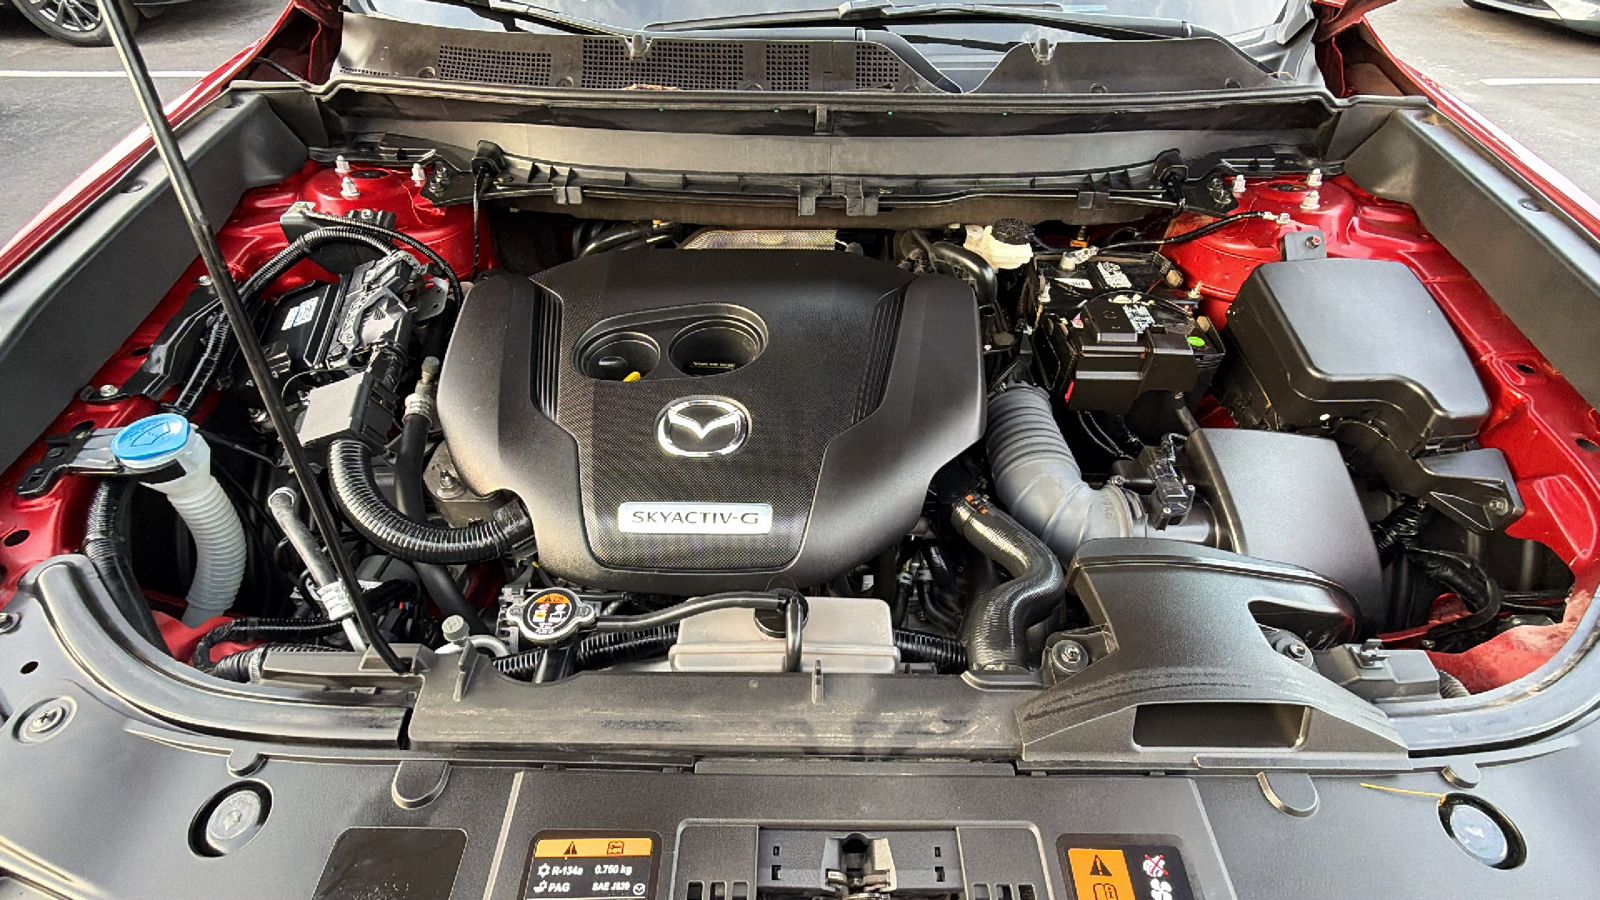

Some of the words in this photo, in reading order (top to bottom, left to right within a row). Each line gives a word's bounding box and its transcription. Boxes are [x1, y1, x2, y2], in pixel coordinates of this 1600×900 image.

[632, 511, 759, 524] SKYACTIV-G
[551, 865, 583, 876] R-134a
[620, 864, 633, 876] kg
[547, 882, 571, 893] PAG
[591, 881, 610, 892] SAE
